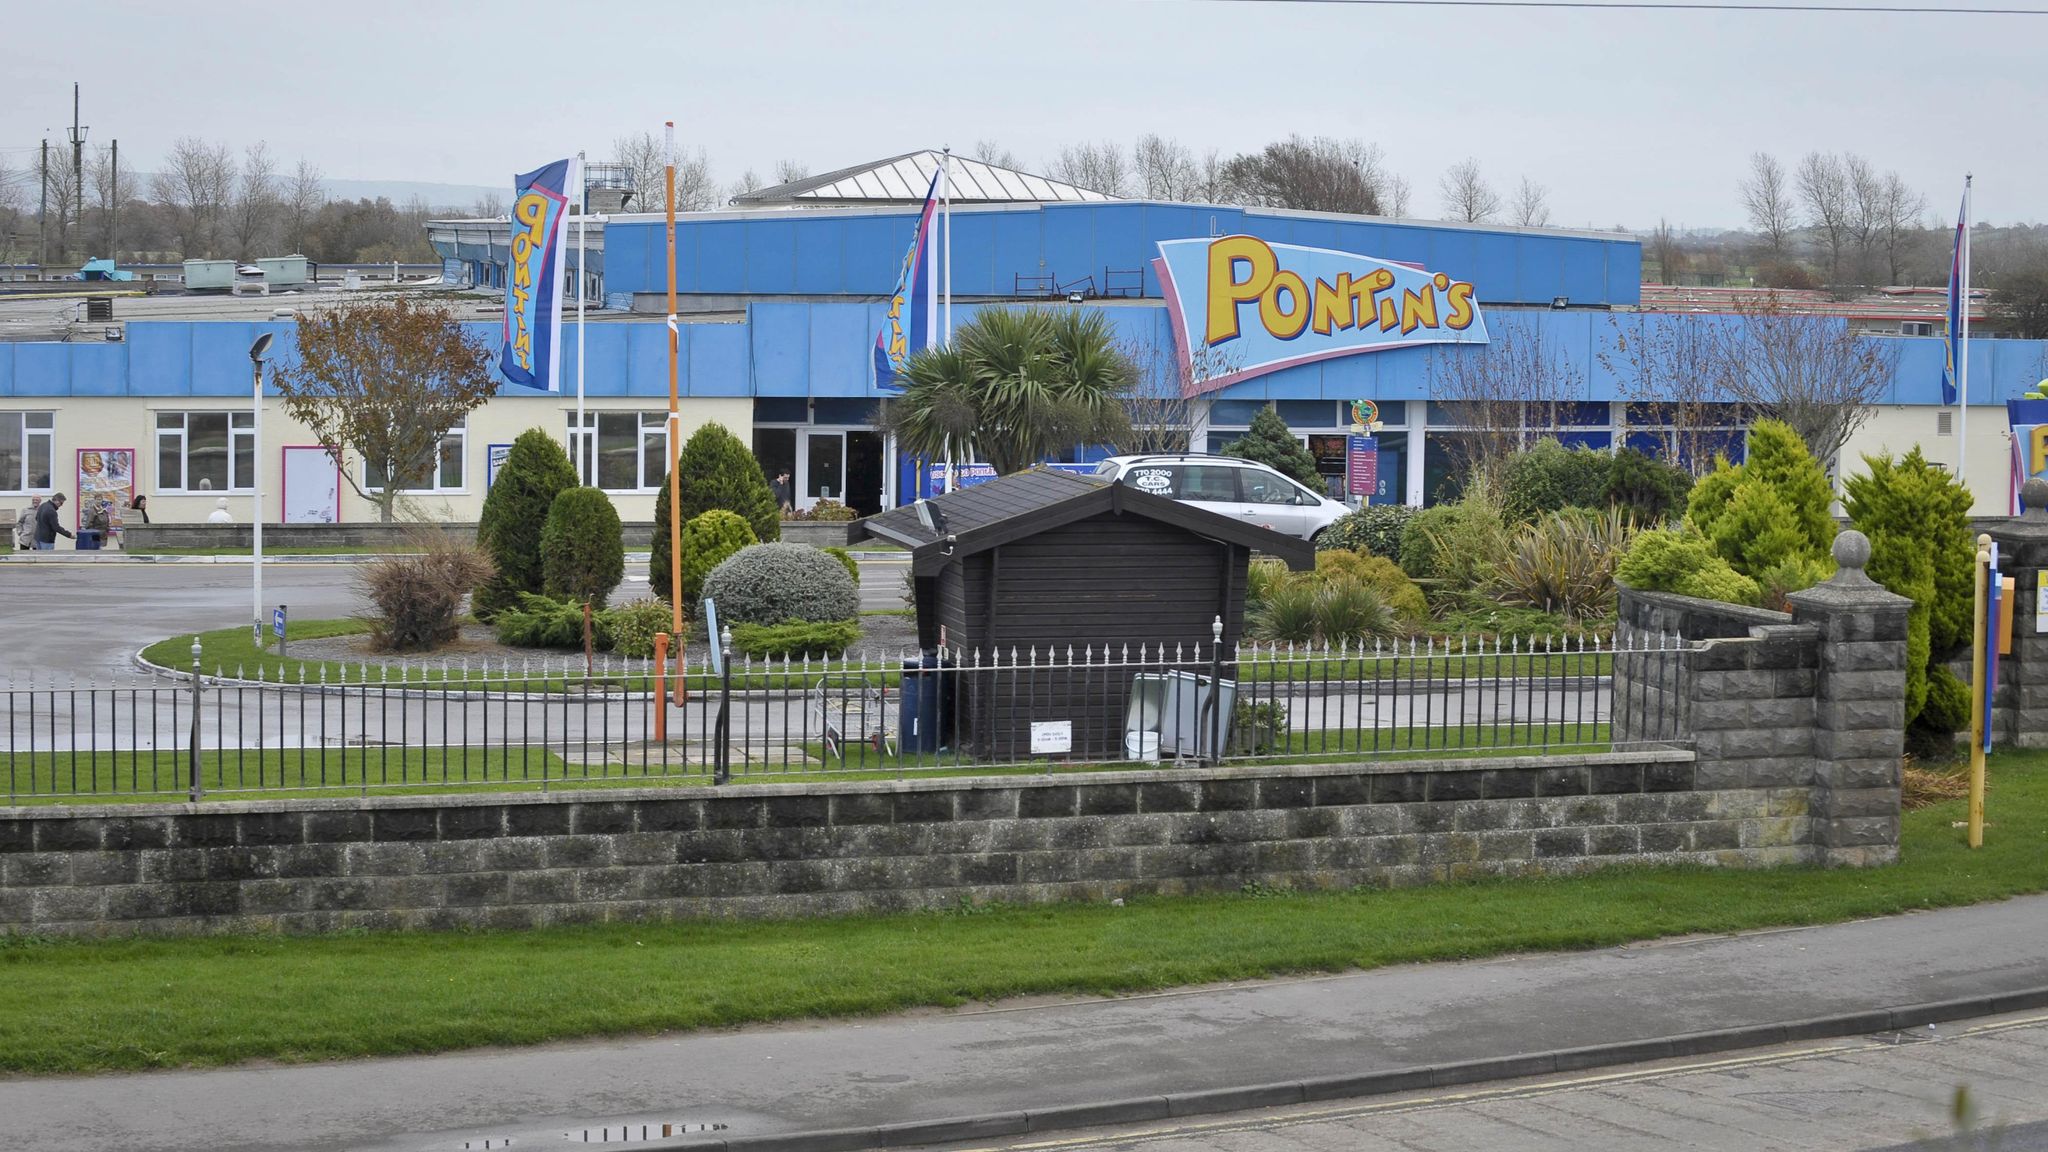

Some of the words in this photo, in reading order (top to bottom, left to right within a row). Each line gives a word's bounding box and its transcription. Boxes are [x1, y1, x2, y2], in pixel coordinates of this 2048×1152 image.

[1207, 236, 1474, 347] PONTIN'S
[1134, 469, 1150, 477] 770
[1150, 469, 1172, 477] 2000
